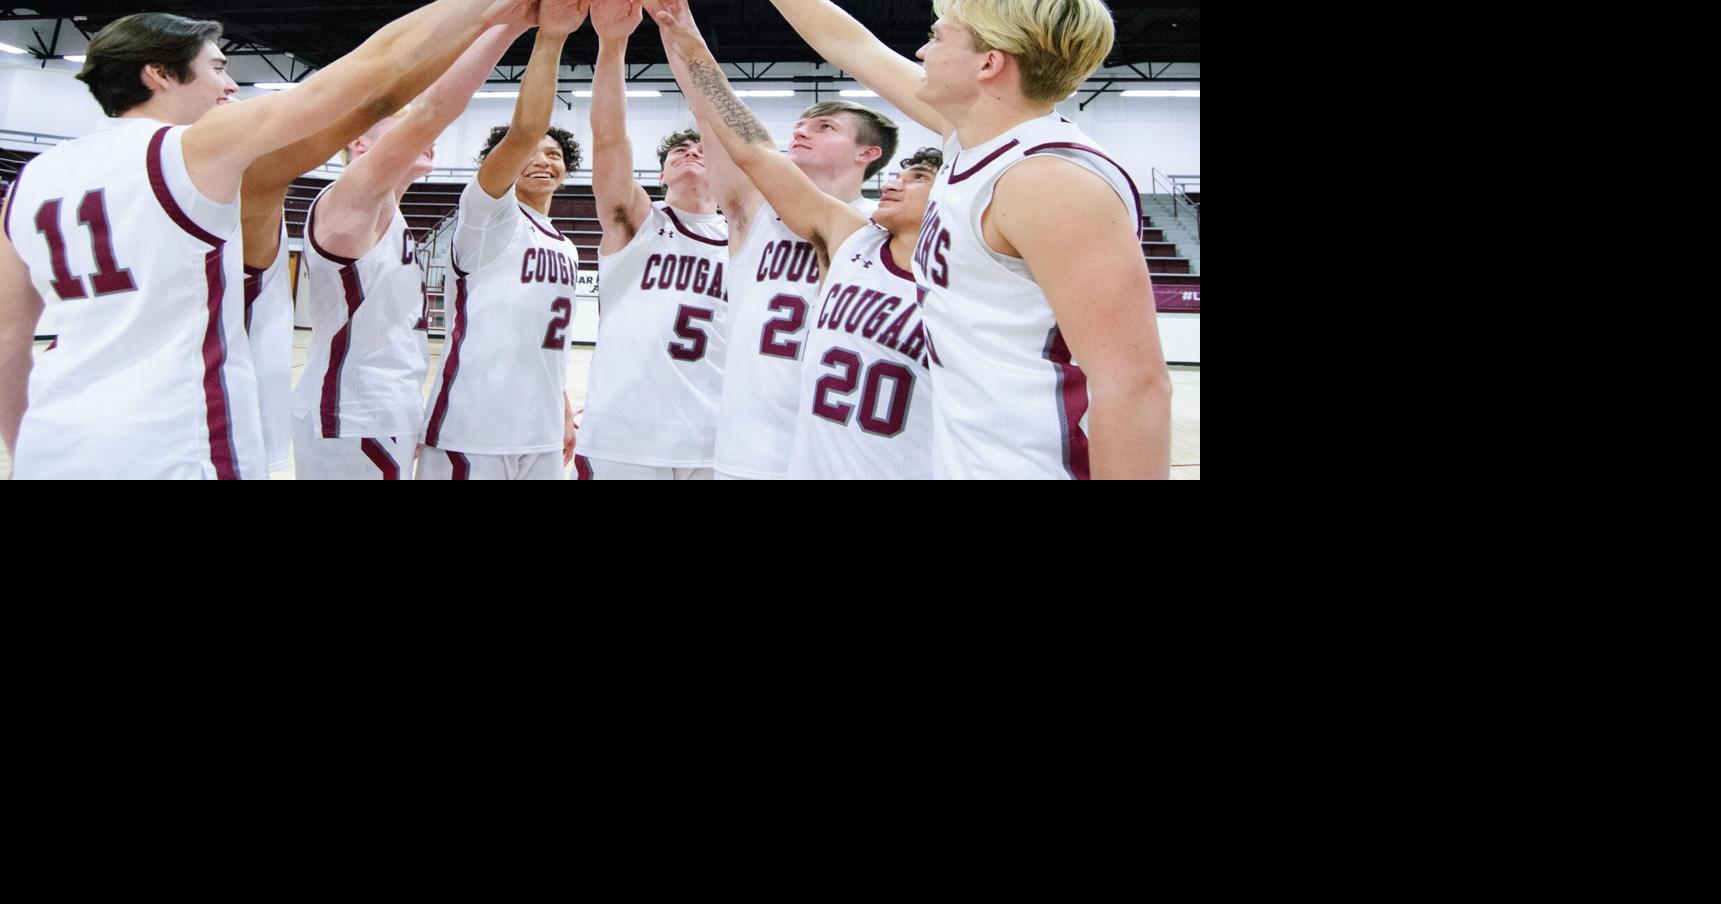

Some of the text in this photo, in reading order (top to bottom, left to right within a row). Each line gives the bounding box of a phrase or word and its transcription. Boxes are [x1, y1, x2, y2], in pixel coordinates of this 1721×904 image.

[34, 187, 139, 301] 11
[640, 253, 729, 302] COUGA
[541, 296, 572, 351] 2
[667, 303, 715, 363] 5
[759, 293, 810, 362] 2
[817, 283, 930, 371] COUGAR
[812, 346, 917, 438] 20
